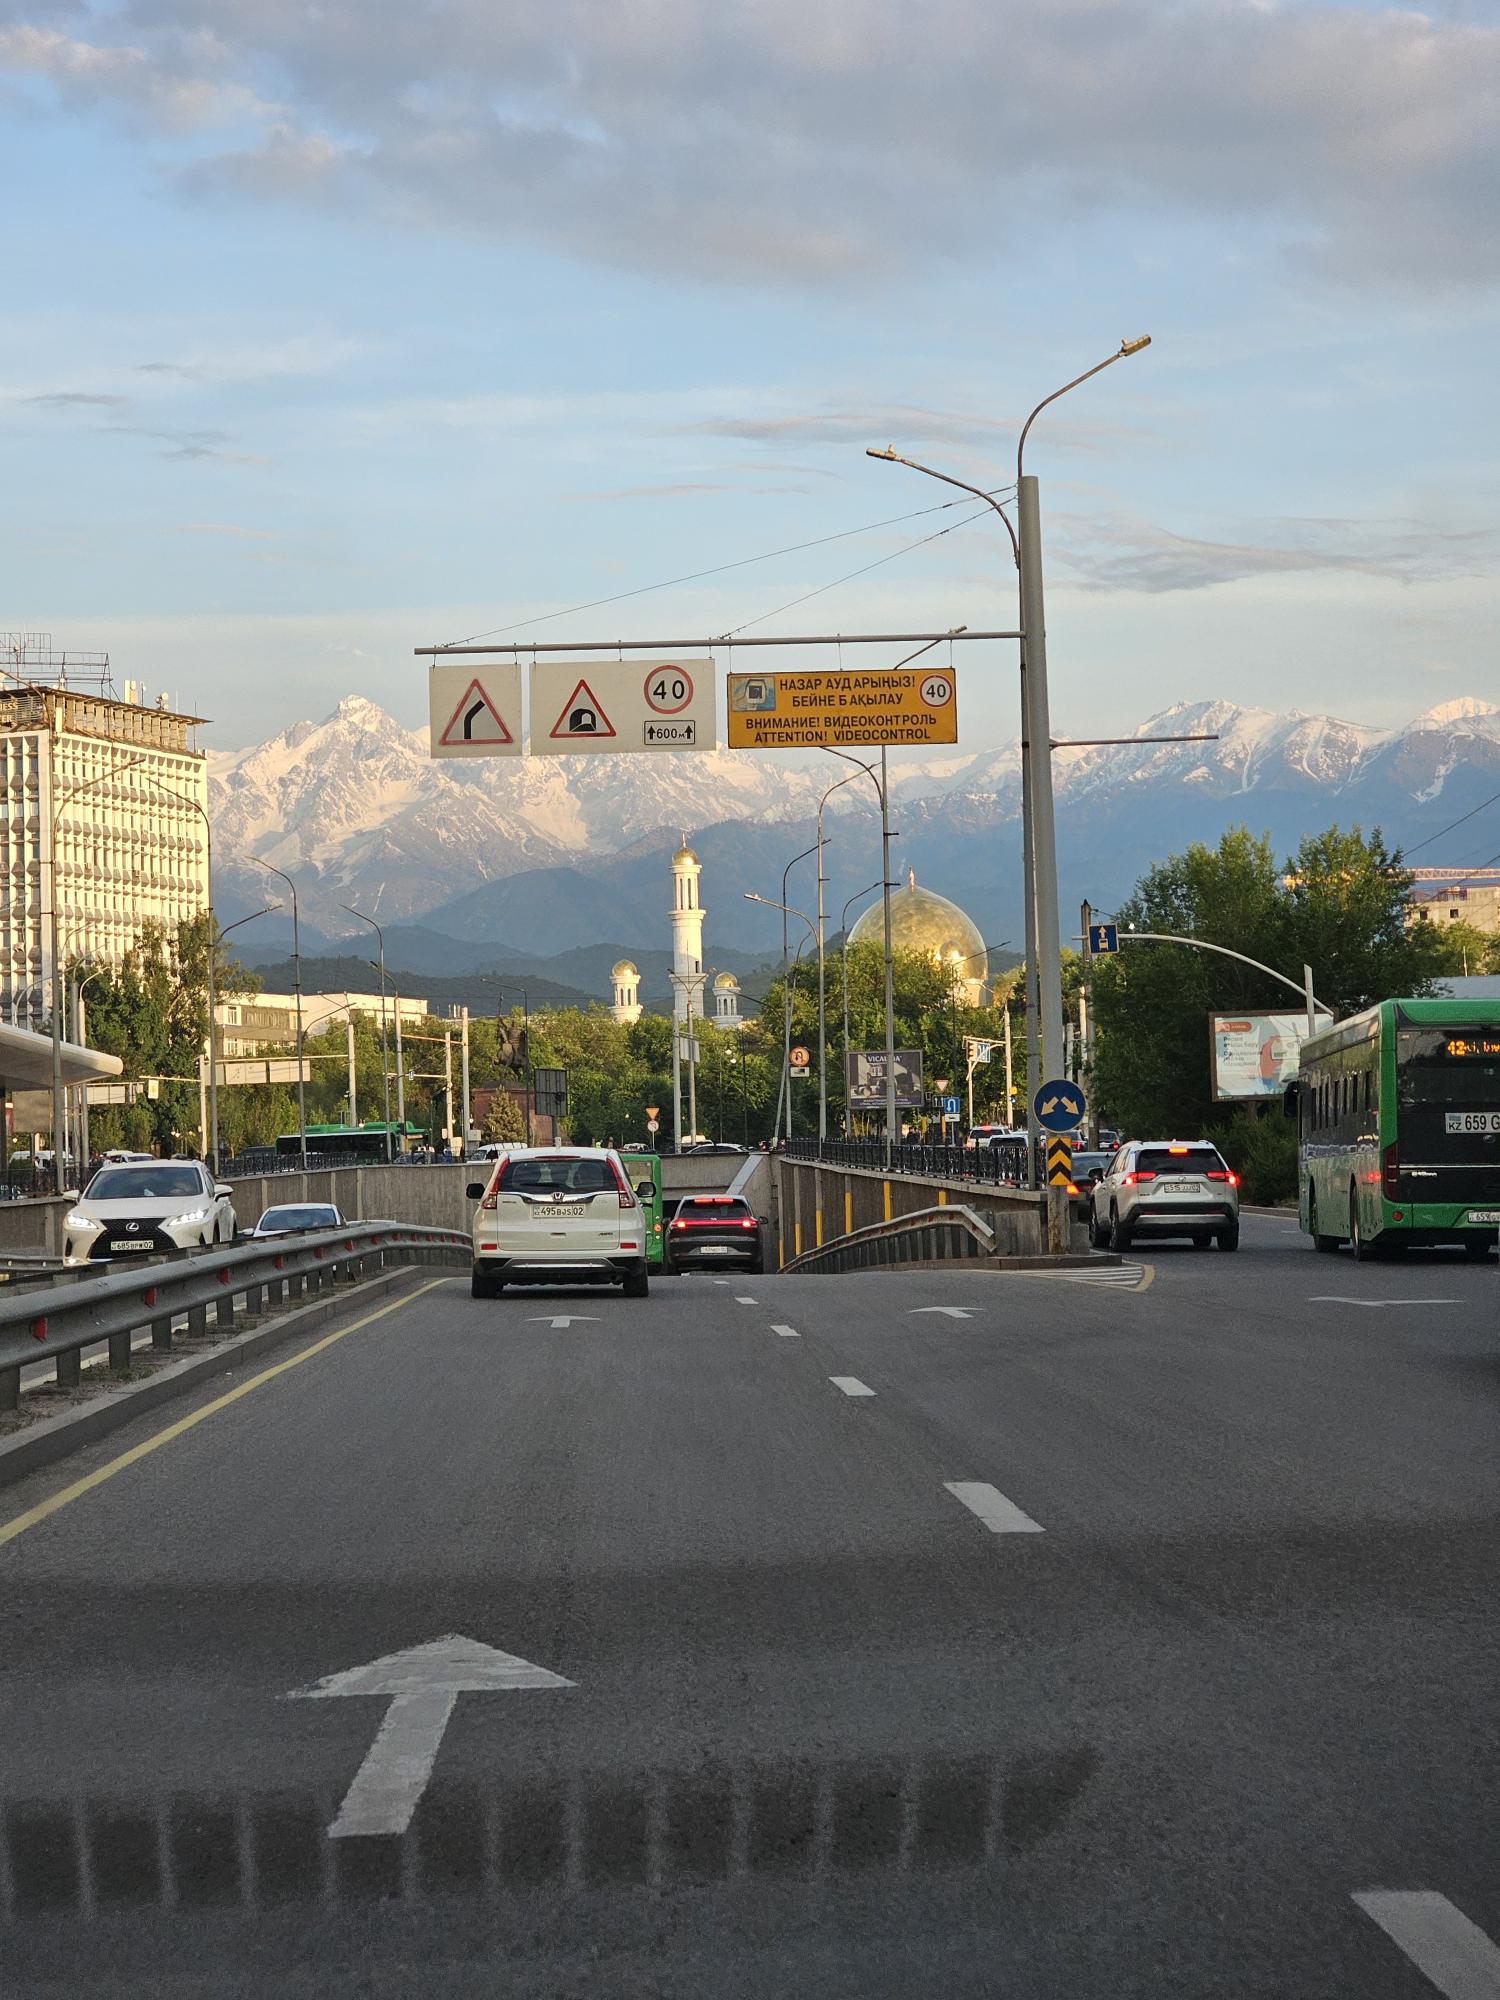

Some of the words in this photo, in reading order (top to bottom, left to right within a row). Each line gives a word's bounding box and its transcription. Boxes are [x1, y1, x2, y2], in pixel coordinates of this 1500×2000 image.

[653, 680, 685, 699] 40
[780, 679, 822, 690] НАЗАР
[926, 684, 946, 698] 40
[792, 693, 836, 707] БЕЙНЕ
[746, 717, 820, 729] ВНИМАНИЕ!
[824, 714, 937, 729] ВИДЕОКОНТРОЛЬ
[754, 730, 828, 743] ATTENTION!
[833, 728, 931, 741] VIDEOCONTROL
[1449, 1122, 1462, 1131] KZ
[1465, 1115, 1487, 1131] 659
